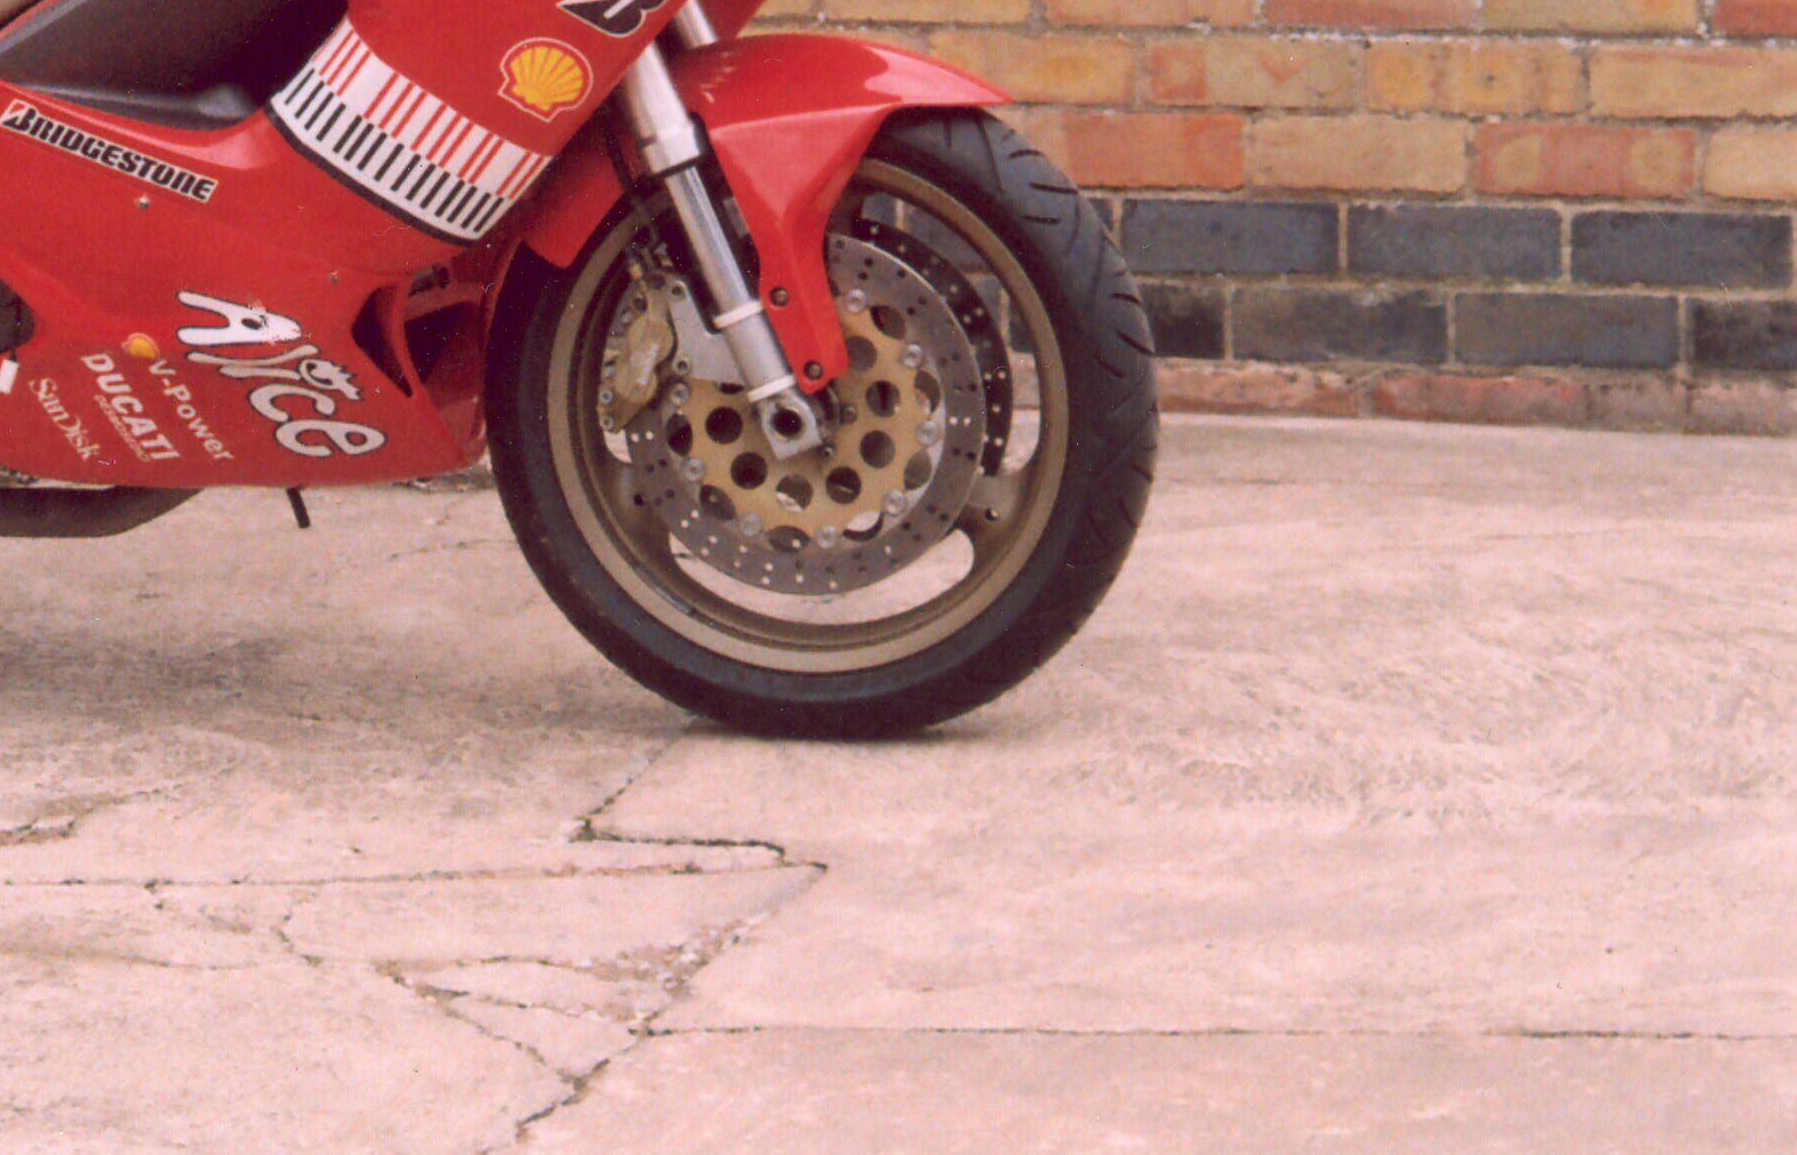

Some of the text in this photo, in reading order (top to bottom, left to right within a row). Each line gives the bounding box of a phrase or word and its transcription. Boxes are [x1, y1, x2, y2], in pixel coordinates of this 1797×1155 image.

[0, 103, 215, 201] BRIDGESTONE
[28, 377, 100, 460] SanDisk
[80, 353, 181, 459] DUCATI
[149, 358, 234, 459] V-Power
